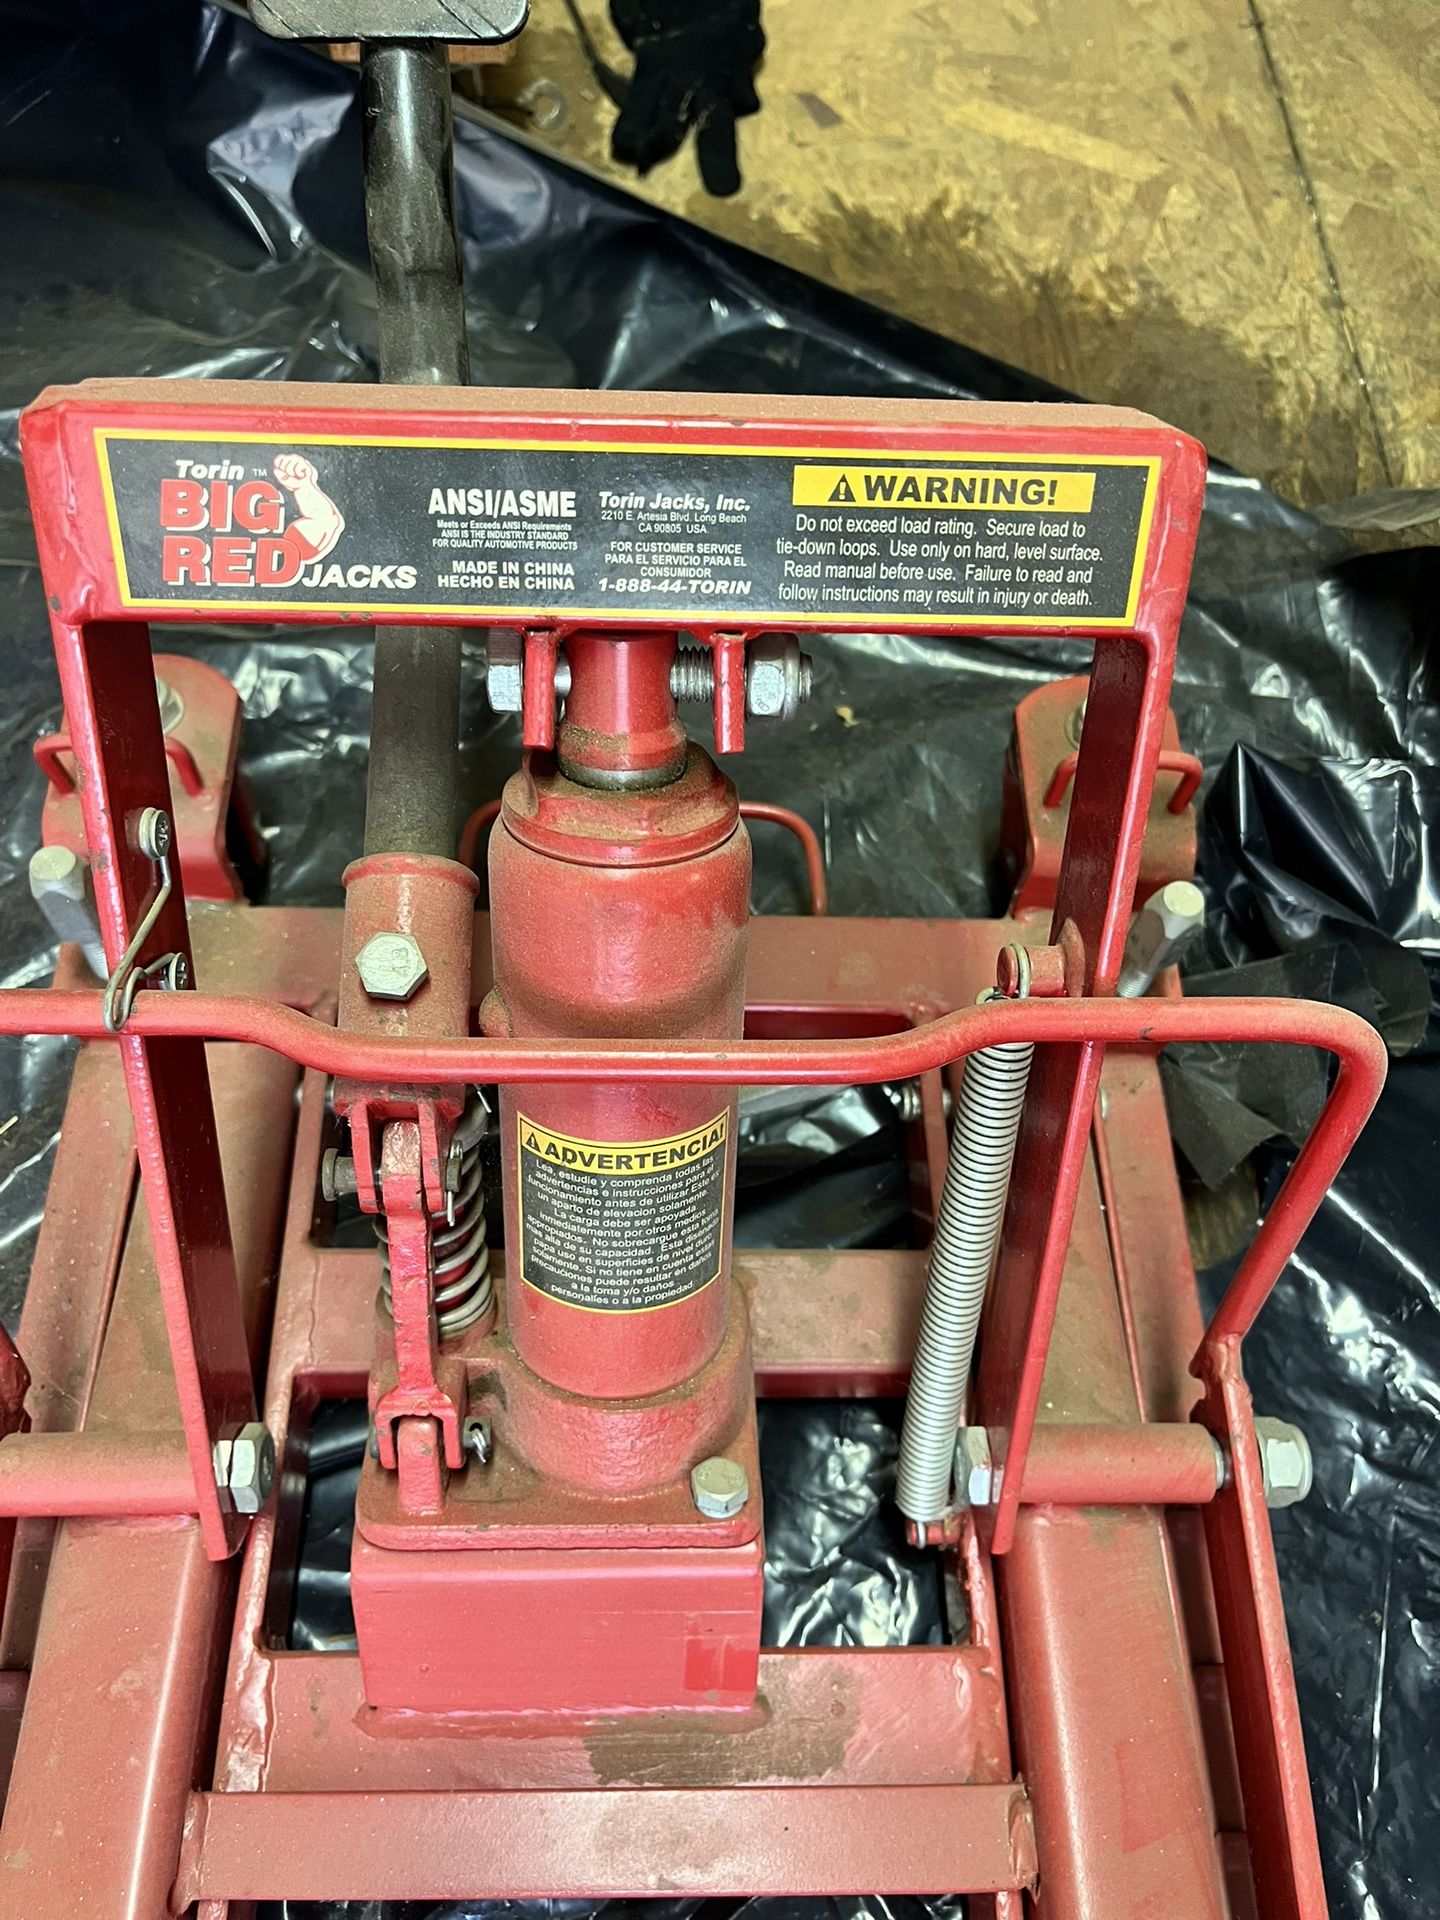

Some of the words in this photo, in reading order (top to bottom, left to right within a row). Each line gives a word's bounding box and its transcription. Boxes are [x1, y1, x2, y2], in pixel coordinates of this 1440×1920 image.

[175, 459, 244, 480] Torin
[598, 491, 645, 508] Torin
[649, 493, 710, 514] Jacks,
[716, 494, 751, 511] Inc.
[864, 475, 1058, 506] WARNING!
[160, 479, 284, 534] BIG
[428, 487, 577, 519] ANSI/ASME
[436, 519, 459, 529] Meets
[470, 520, 501, 530] Exceeds
[502, 522, 521, 530] ANSI
[522, 522, 572, 532] Requirements
[601, 510, 624, 521] 2210
[626, 511, 635, 521] E.
[636, 511, 668, 522] Artesia
[670, 512, 692, 523] Blvd.
[694, 513, 716, 525] Long
[719, 513, 747, 523] Beach
[638, 523, 652, 533] CA
[654, 524, 682, 534] 90805
[796, 513, 816, 532] Do
[820, 516, 843, 532] not
[846, 516, 897, 533] exceed
[900, 516, 931, 534] load
[934, 517, 977, 539] rating.
[986, 518, 1036, 537] Secure
[1039, 520, 1069, 537] load
[1072, 521, 1086, 538] to
[432, 538, 449, 547] FOR
[450, 539, 484, 548] QUALITY
[484, 539, 535, 549] AUTOMOTIVE
[536, 541, 578, 550] PRODUCTS
[441, 530, 460, 538] ANSI
[461, 530, 469, 538] IS
[470, 530, 486, 539] THE
[487, 530, 526, 539] INDUSTRY
[527, 531, 569, 541] STANDARD
[604, 553, 633, 564] PARA
[635, 554, 649, 565] EL
[652, 555, 701, 566] SERVICIO
[703, 556, 731, 566] PARA
[734, 556, 747, 567] EL
[610, 542, 632, 552] FOR
[635, 542, 694, 553] CUSTOMER
[696, 544, 742, 554] SERVICE
[776, 537, 835, 555] tie-down
[839, 539, 880, 560] loops.
[889, 539, 917, 557] Use
[921, 541, 950, 562] only
[953, 545, 971, 558] on
[975, 541, 1009, 561] hard,
[1014, 542, 1046, 560] level
[1049, 543, 1103, 561] surface.
[162, 535, 302, 588] RED
[301, 563, 418, 589] JACKS
[452, 560, 498, 574] MADE
[502, 562, 520, 575] IN
[524, 562, 575, 576] CHINA
[640, 566, 711, 578] CONSUMIDOR
[784, 560, 821, 578] Read
[825, 562, 876, 579] manual
[880, 562, 924, 580] before
[927, 568, 956, 581] use.
[965, 564, 1012, 582] Failure
[1016, 566, 1029, 582] to
[1032, 566, 1063, 583] read
[1066, 566, 1093, 584] and
[437, 575, 494, 589] HECHO
[498, 576, 520, 589] EN
[524, 577, 575, 590] CHINA
[598, 578, 752, 595] 1-888-44-TORIN
[778, 583, 819, 600] follow
[822, 584, 899, 602] instructions
[903, 589, 933, 607] may
[936, 587, 974, 603] result
[978, 588, 990, 604] in
[993, 588, 1030, 608] injury
[1034, 591, 1048, 605] or
[1051, 589, 1092, 606] death.
[545, 1123, 724, 1170] ADVERTENCIA!
[535, 1170, 599, 1196] advertencias
[612, 1181, 683, 1197] instrucciones
[686, 1170, 705, 1187] para
[558, 1170, 597, 1186] estudie
[600, 1180, 607, 1188] y
[610, 1174, 672, 1188] comprenda
[675, 1164, 701, 1179] todas
[528, 1174, 602, 1206] funcionamiento
[605, 1198, 636, 1207] antes
[639, 1198, 653, 1206] de
[537, 1191, 549, 1202] un
[586, 1207, 600, 1216] de
[554, 1207, 567, 1219] La
[569, 1214, 599, 1227] carga
[602, 1219, 630, 1227] debe
[654, 1205, 696, 1225] apoyada
[624, 1229, 643, 1238] por
[645, 1224, 672, 1235] otros
[674, 1209, 706, 1228] medios
[592, 1237, 608, 1247] No
[611, 1232, 678, 1247] sobrecargue
[681, 1222, 700, 1236] esta
[557, 1250, 576, 1260] uso
[579, 1256, 592, 1264] en
[595, 1256, 654, 1268] superficies
[656, 1254, 670, 1262] de
[672, 1243, 694, 1258] nivel
[563, 1242, 576, 1251] de
[579, 1246, 592, 1255] su
[595, 1247, 654, 1259] capacidad.
[661, 1239, 683, 1252] Esta
[585, 1265, 596, 1274] Si
[616, 1268, 643, 1277] tiene
[645, 1266, 659, 1274] en
[662, 1253, 694, 1271] cuenta
[595, 1278, 630, 1286] puede
[632, 1271, 672, 1285] resultar
[674, 1266, 687, 1276] en
[571, 1282, 578, 1290] a
[580, 1283, 590, 1292] la
[593, 1285, 620, 1295] toma
[623, 1287, 640, 1296] y/o
[612, 1297, 619, 1305] o
[632, 1295, 642, 1304] la
[644, 1281, 693, 1304] propiedad
